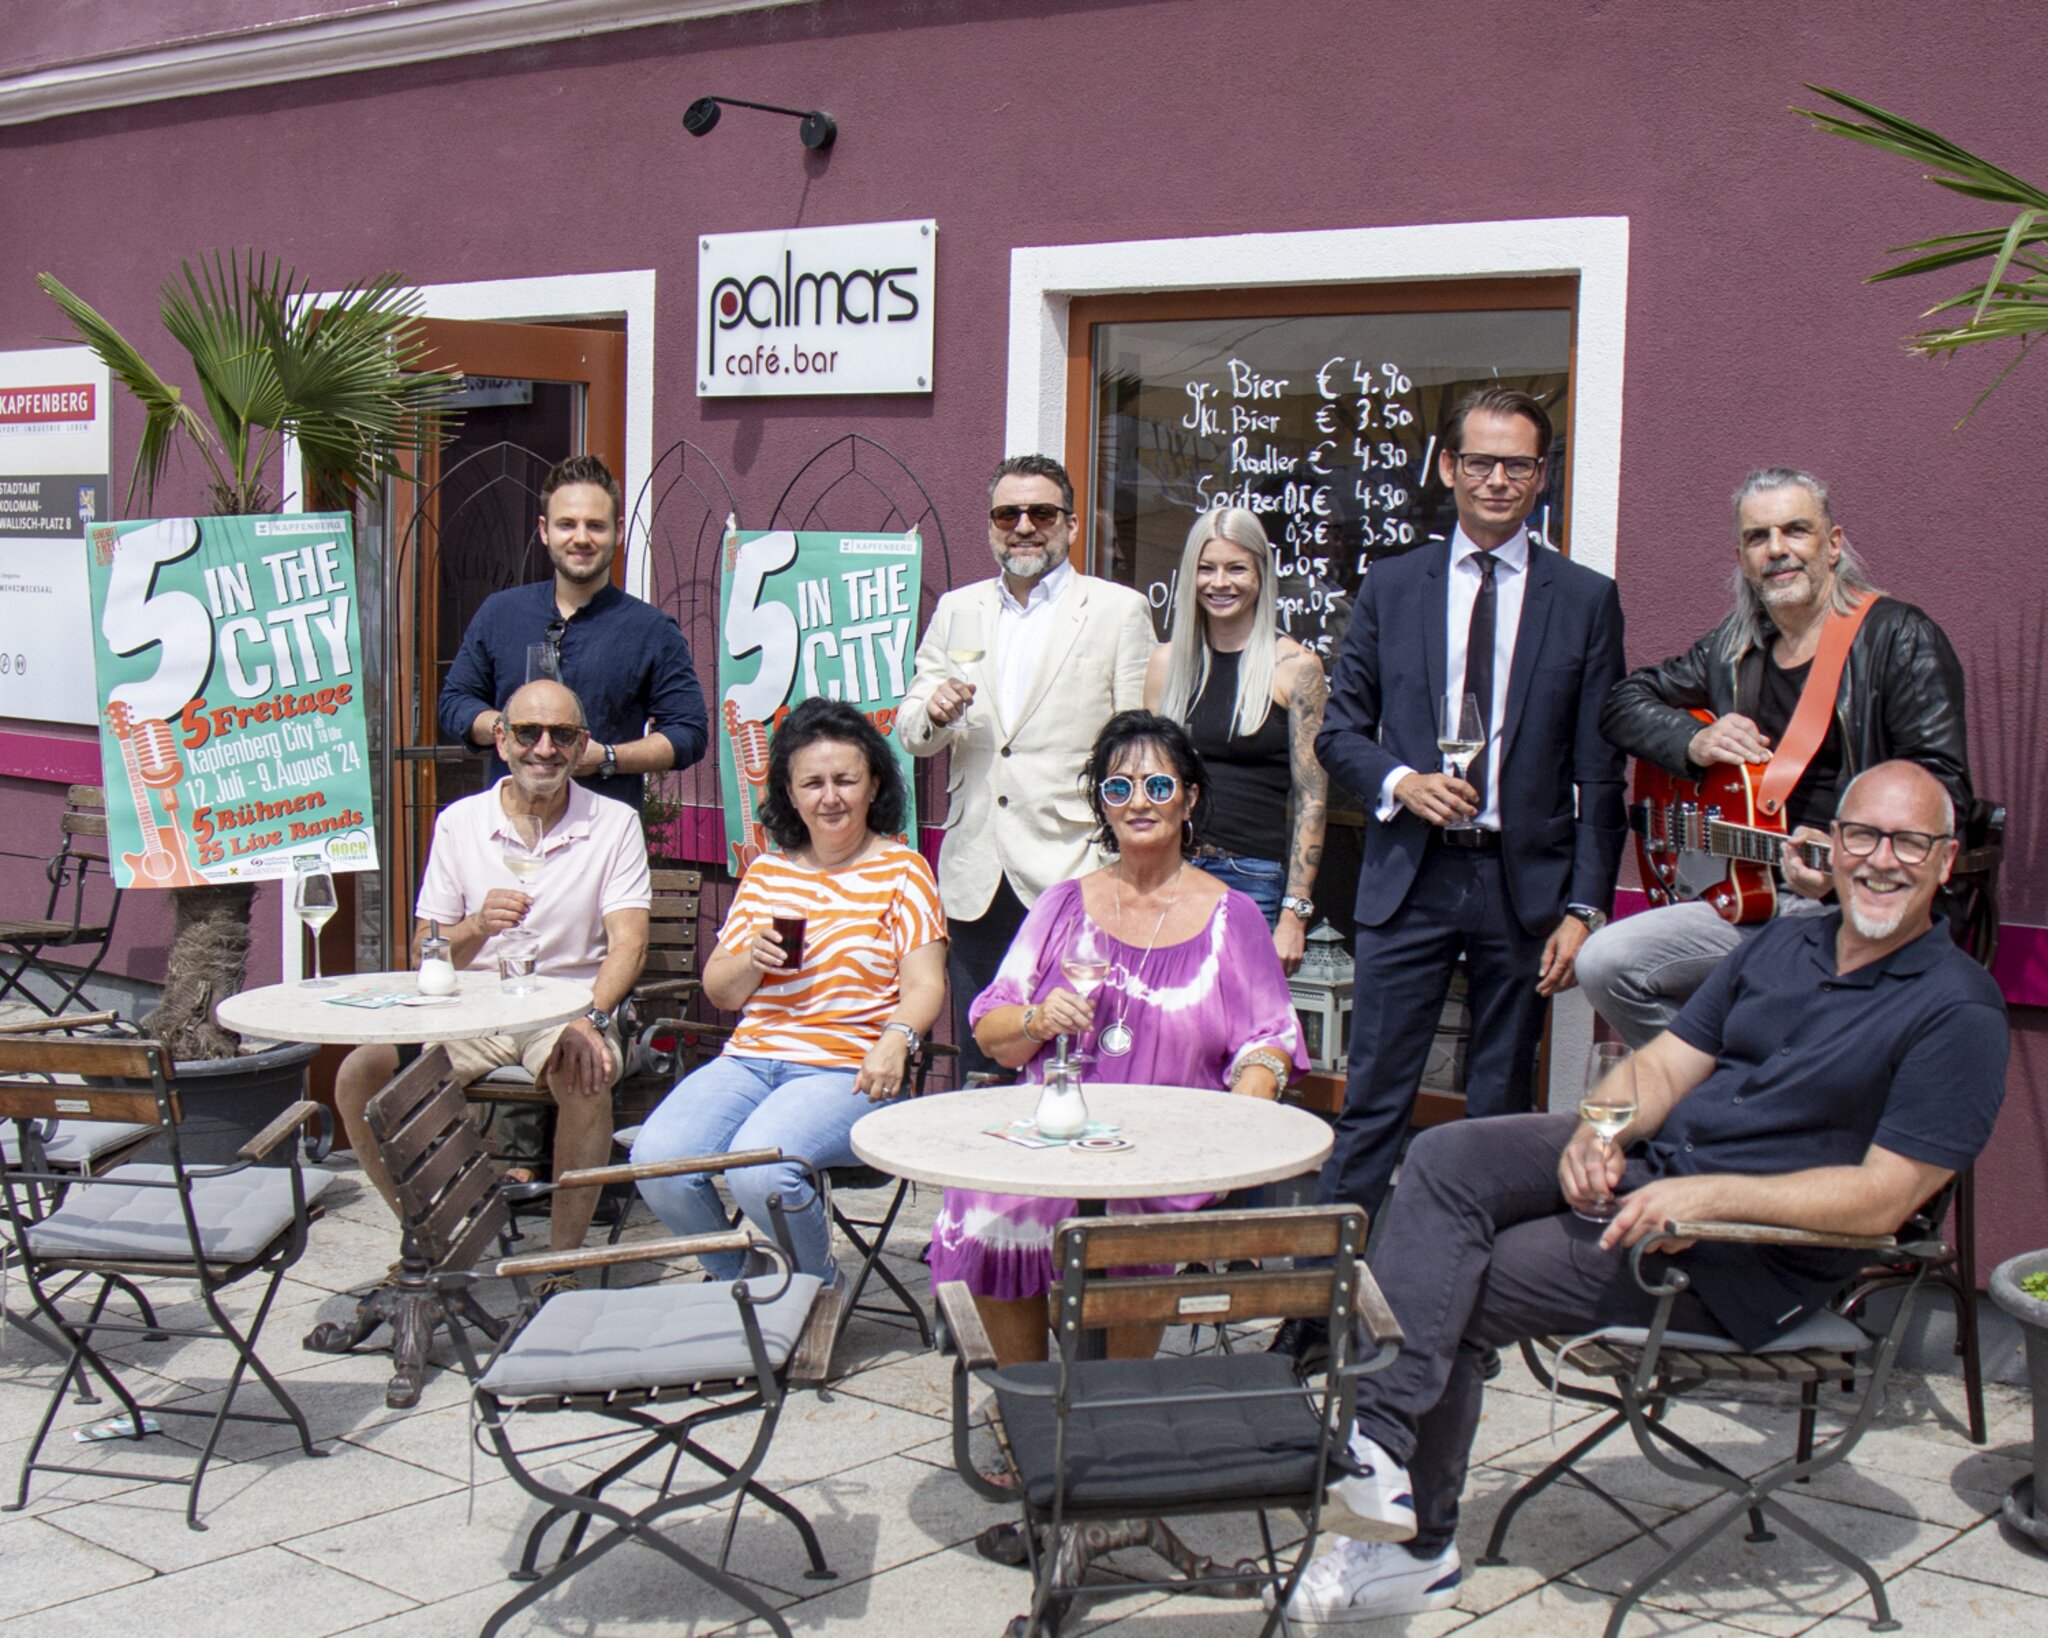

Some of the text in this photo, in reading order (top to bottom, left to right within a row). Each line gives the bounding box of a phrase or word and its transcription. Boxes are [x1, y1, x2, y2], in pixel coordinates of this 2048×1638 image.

[725, 343, 838, 375] café.bar
[0, 391, 88, 415] KAPFENBERG
[1182, 357, 1412, 429] gr. Bier € 4.90
[1232, 405, 1280, 434] Bier
[1315, 404, 1337, 433] €
[1356, 398, 1413, 431] 3.50
[1231, 436, 1408, 475] Radler € 4.90
[1355, 480, 1408, 511] 4.90
[66, 517, 72, 531] 8
[274, 521, 342, 533] KAPFENBERG
[1358, 515, 1414, 548] 3.50
[855, 542, 913, 552] KAPFENBERG
[204, 541, 347, 618] IN THE
[797, 563, 911, 631] IN THE
[102, 517, 217, 722] 5
[725, 530, 800, 726] 5
[180, 683, 353, 749] 5 Freitage
[313, 715, 325, 730] ab
[186, 721, 314, 775] Kapfenberg City
[215, 768, 246, 803] Juli
[192, 791, 327, 844] 5 Bühnen
[198, 808, 365, 866] 25 Live Bands
[331, 841, 367, 857] HOCH
